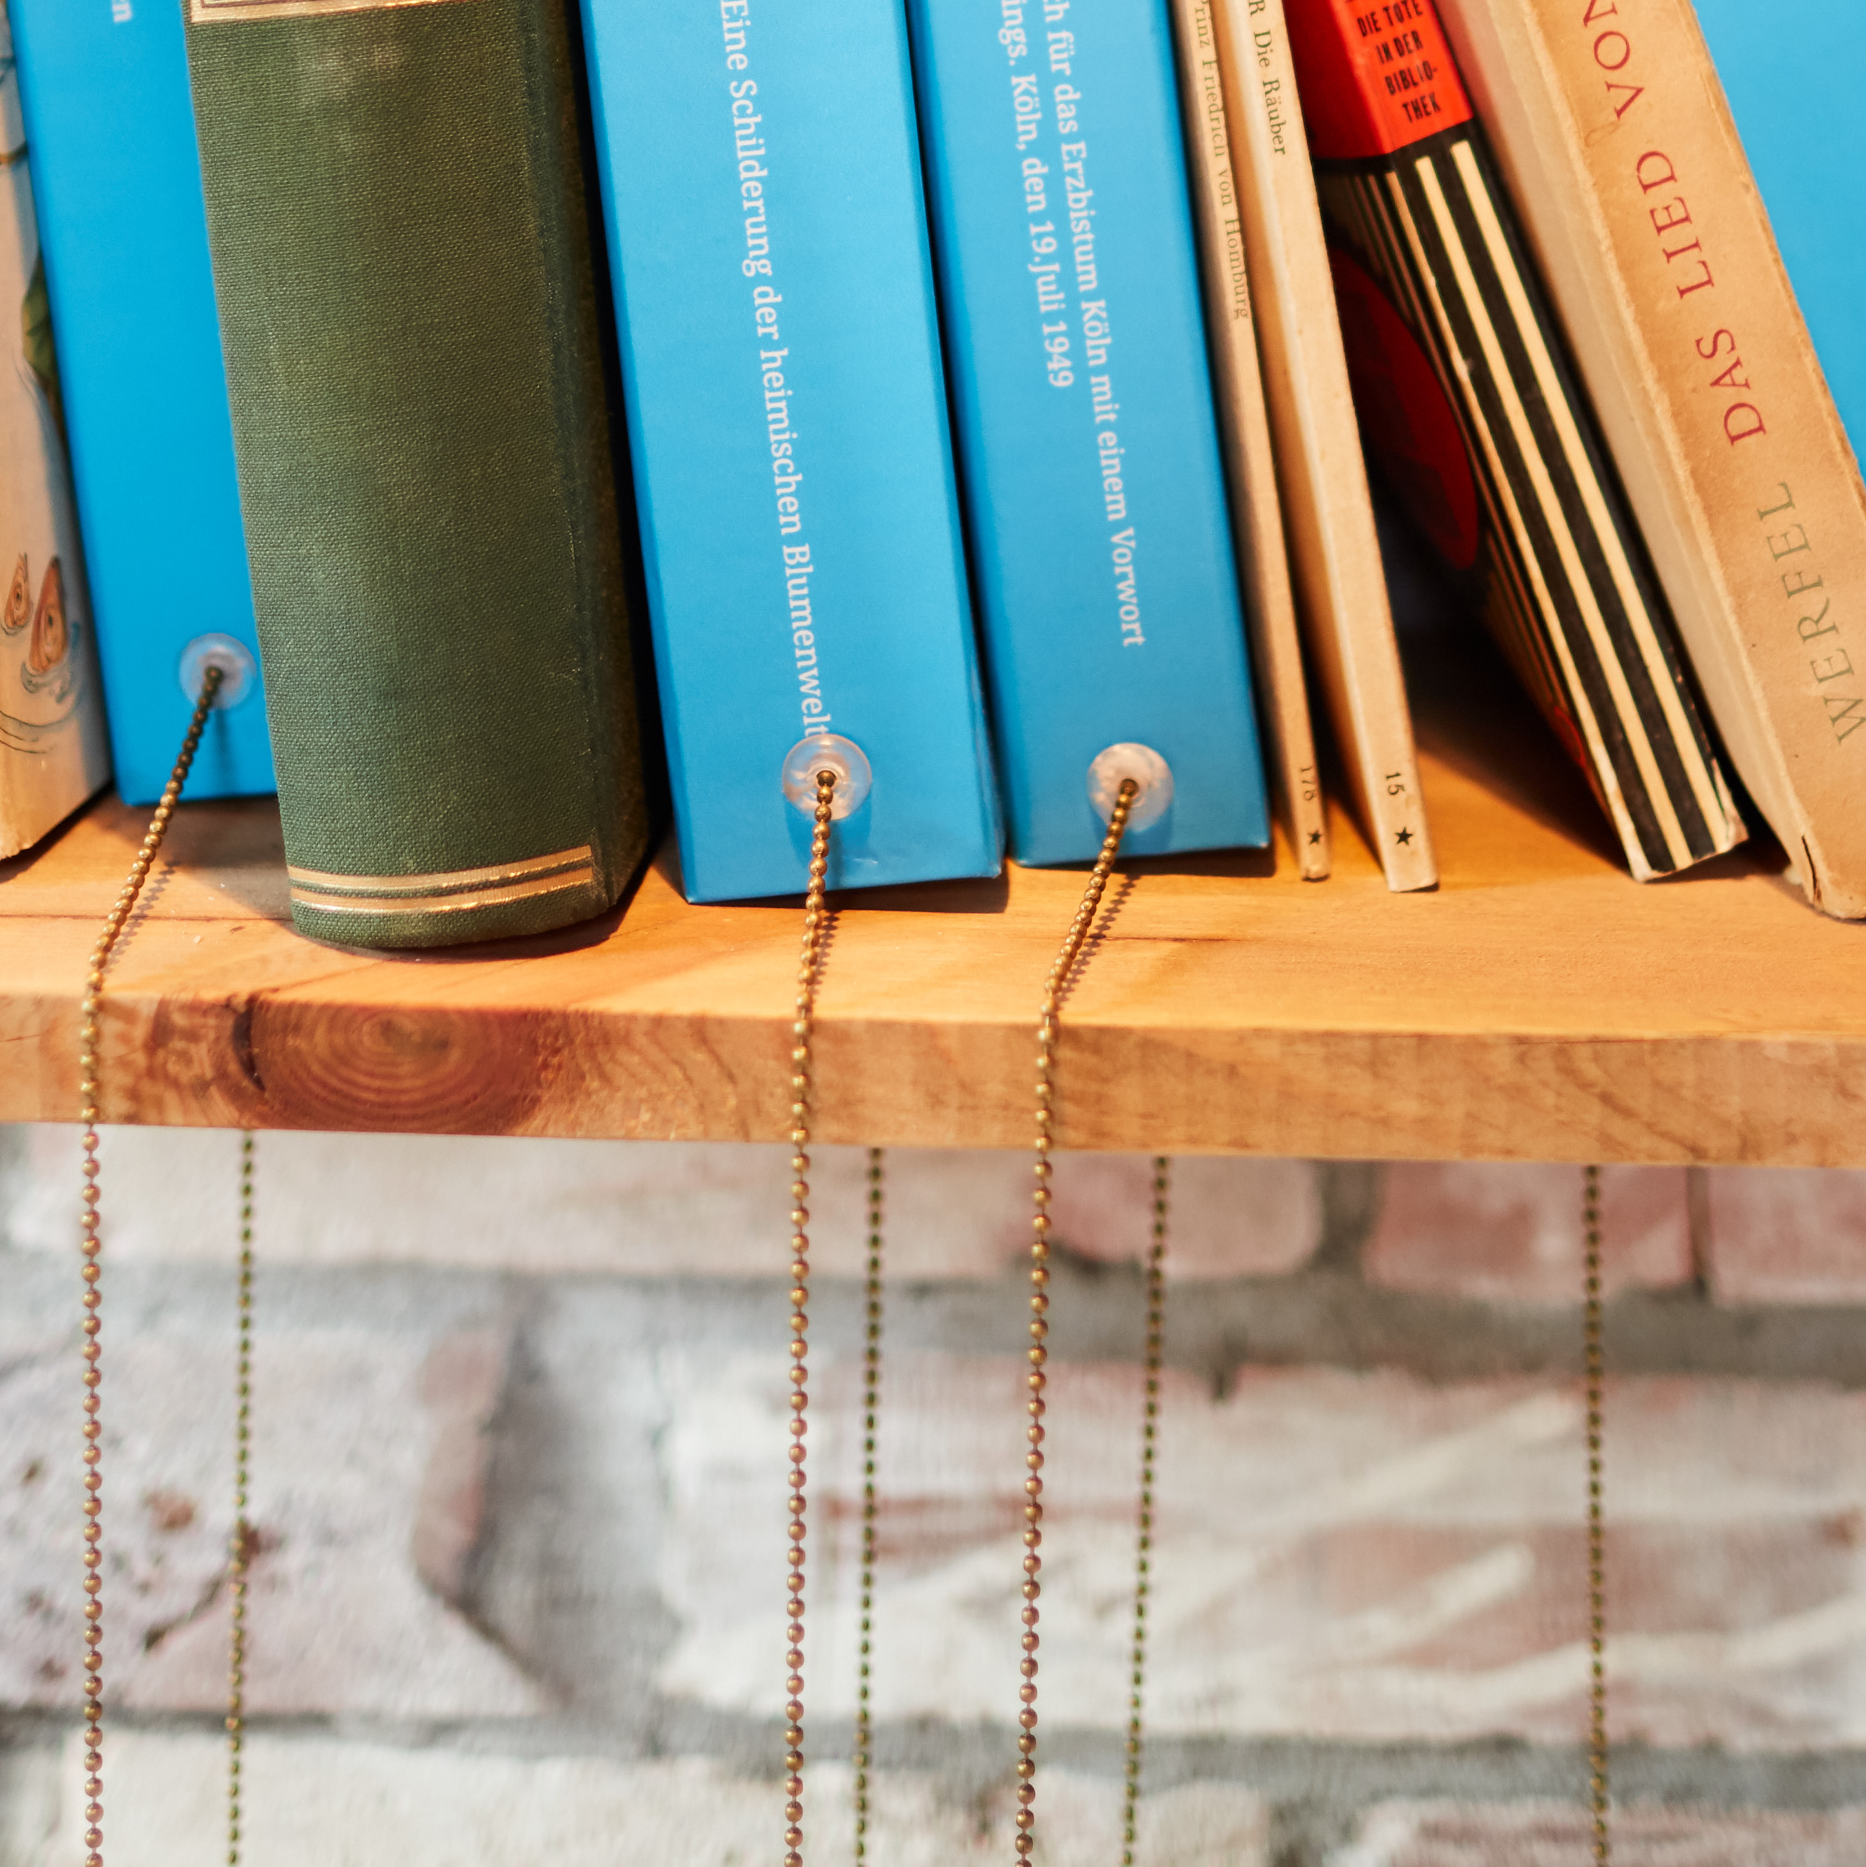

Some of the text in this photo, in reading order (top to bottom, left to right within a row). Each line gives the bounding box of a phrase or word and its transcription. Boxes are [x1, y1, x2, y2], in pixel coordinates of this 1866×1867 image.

[1046, 31, 1076, 78] für
[1253, 29, 1272, 70] Die
[1357, 9, 1382, 38] DIE
[1376, 30, 1424, 65] IN DER
[1010, 75, 1042, 152] Köln,
[1053, 82, 1081, 134] das
[1201, 59, 1228, 158] Friedrich
[1261, 77, 1287, 156] Räuber
[1402, 92, 1441, 125] THEK
[730, 79, 775, 279] Schilderung
[1021, 157, 1051, 214] den
[1217, 168, 1234, 208] von
[1060, 141, 1099, 291] Erzbistum
[1636, 148, 1716, 300] LIED
[1225, 217, 1250, 321] Homburg
[752, 285, 782, 342] der
[1080, 298, 1110, 368] Köln
[1041, 320, 1075, 390] 1949
[1695, 327, 1768, 446] DAS
[1089, 373, 1118, 425] mit
[758, 349, 804, 538] heimischen
[1096, 431, 1129, 523] einem
[1109, 526, 1147, 648] Vorwort
[1385, 771, 1406, 796] 15
